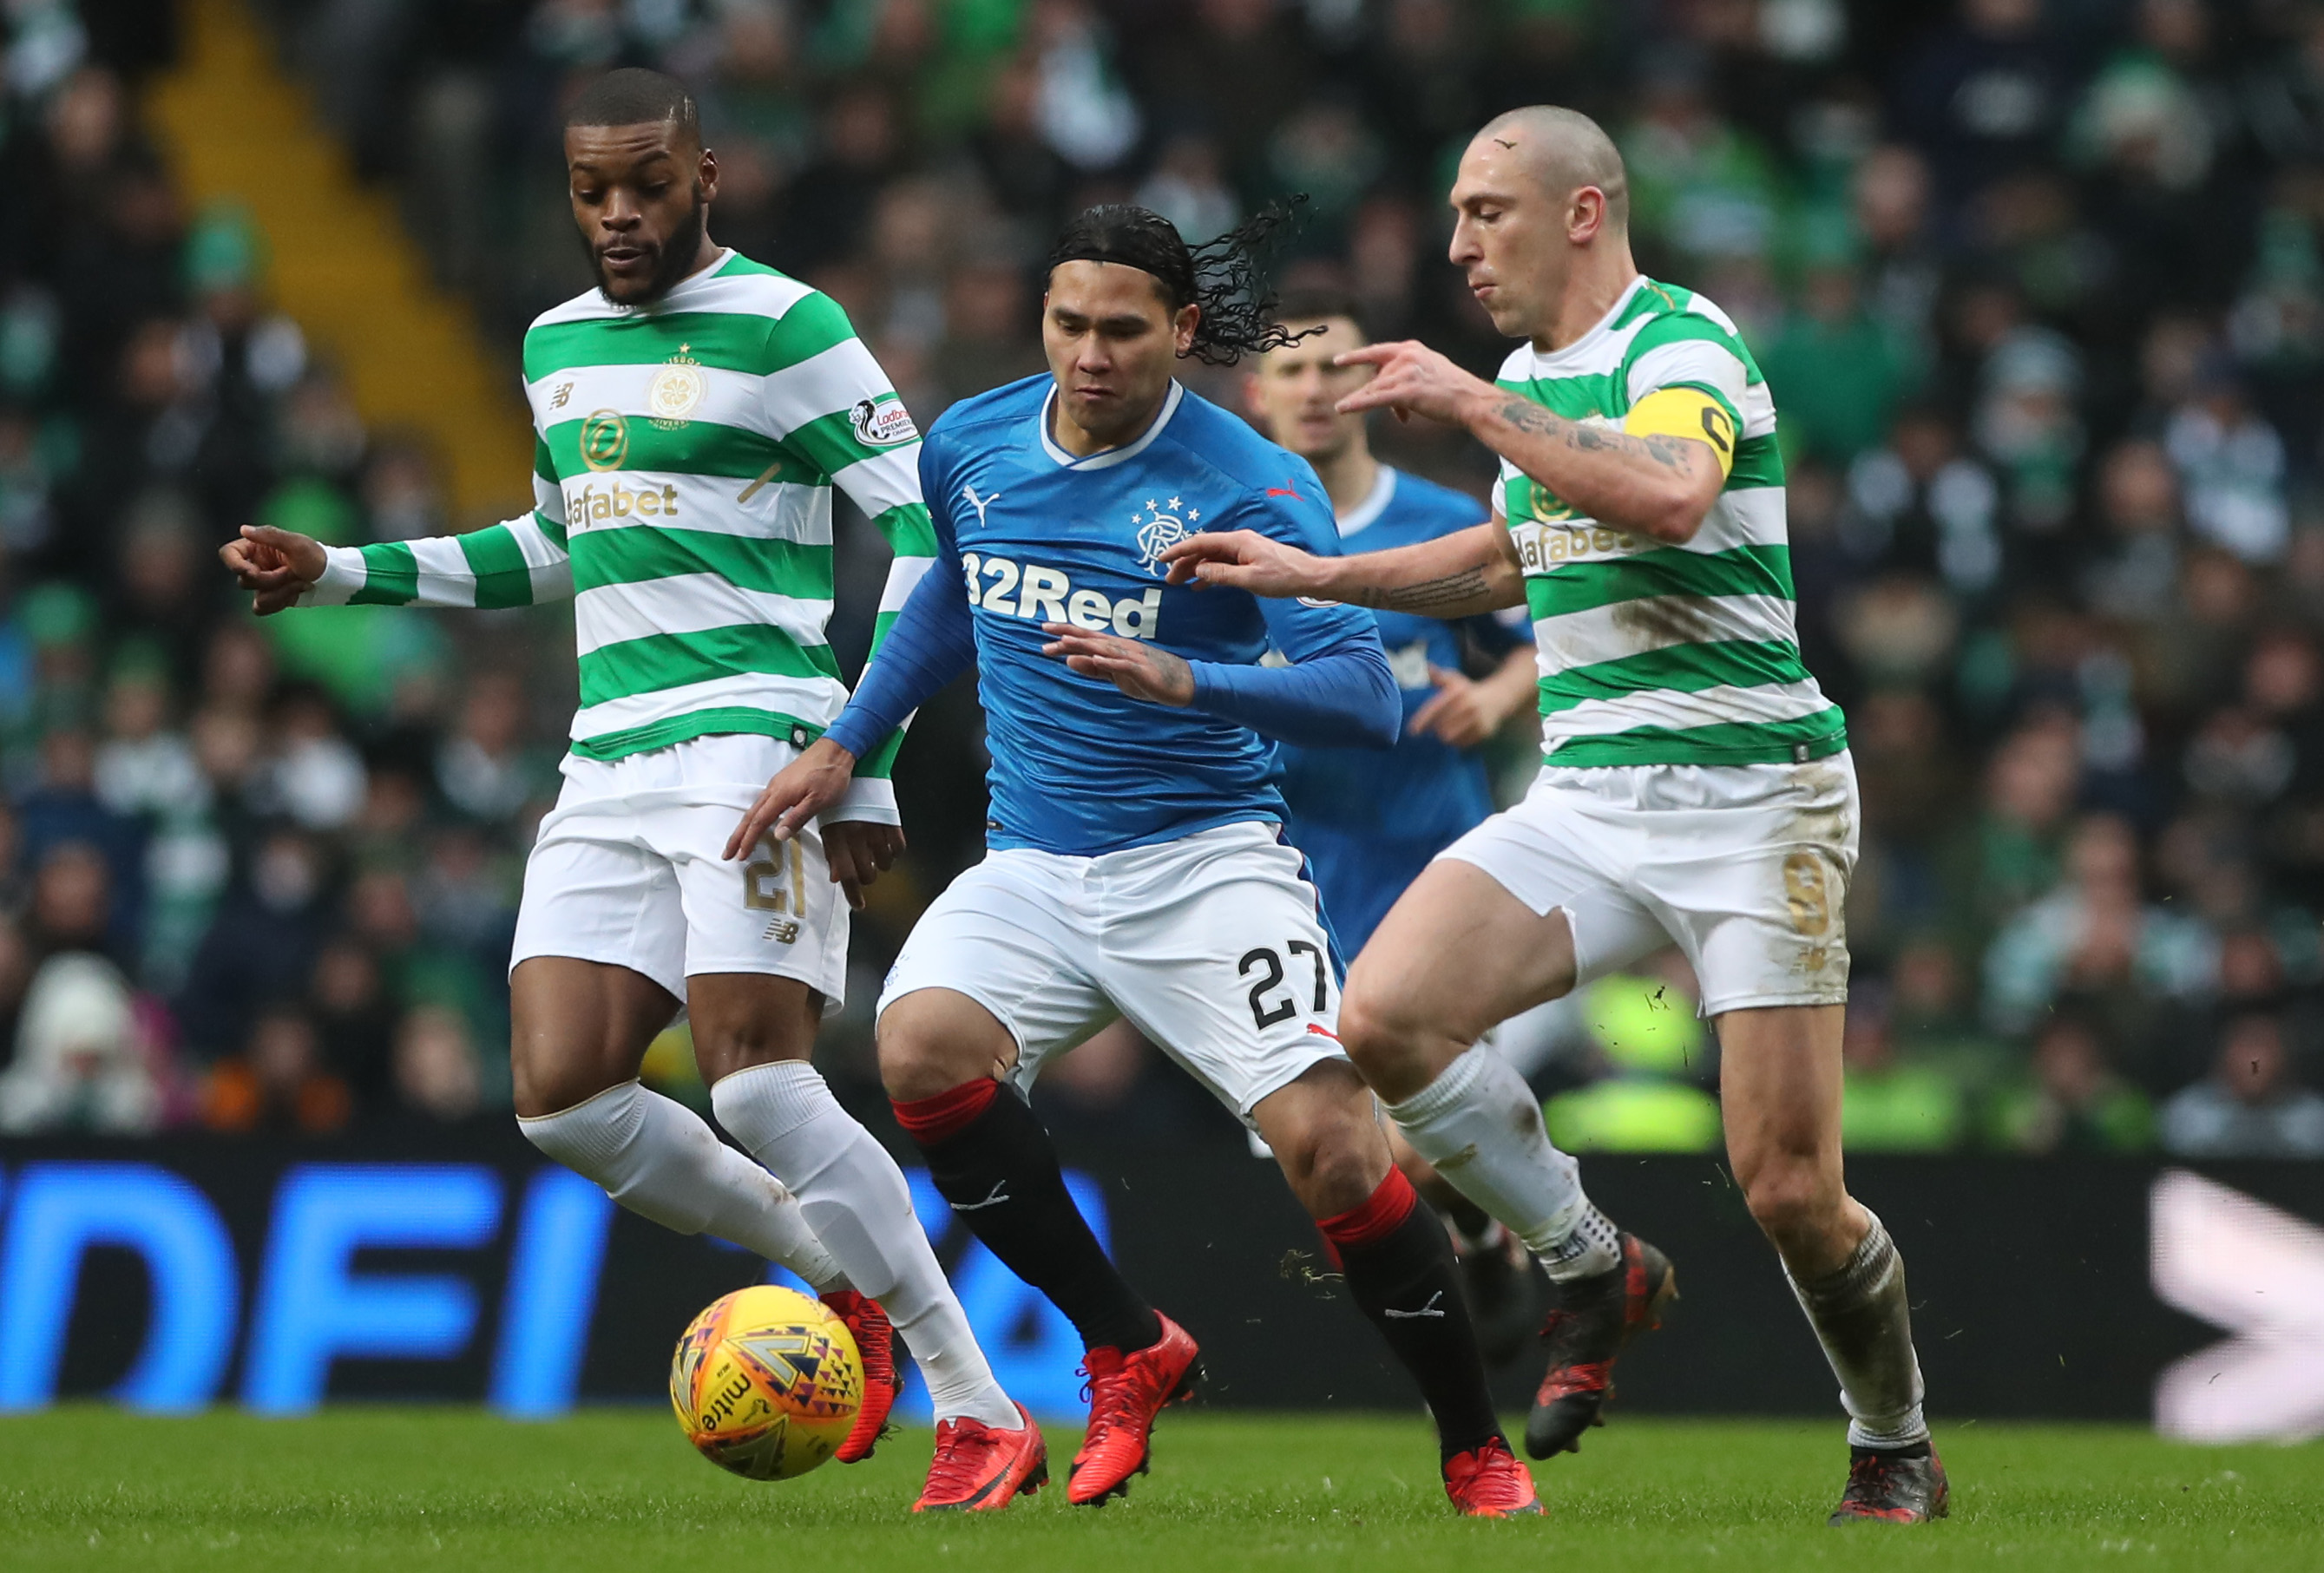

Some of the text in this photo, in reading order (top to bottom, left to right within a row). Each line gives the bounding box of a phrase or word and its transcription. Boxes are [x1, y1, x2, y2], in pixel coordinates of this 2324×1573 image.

[1702, 406, 1730, 452] C
[962, 552, 1163, 639] 32Red
[744, 826, 805, 918] 21
[1238, 940, 1326, 1030] 27
[702, 1373, 752, 1431] mitre
